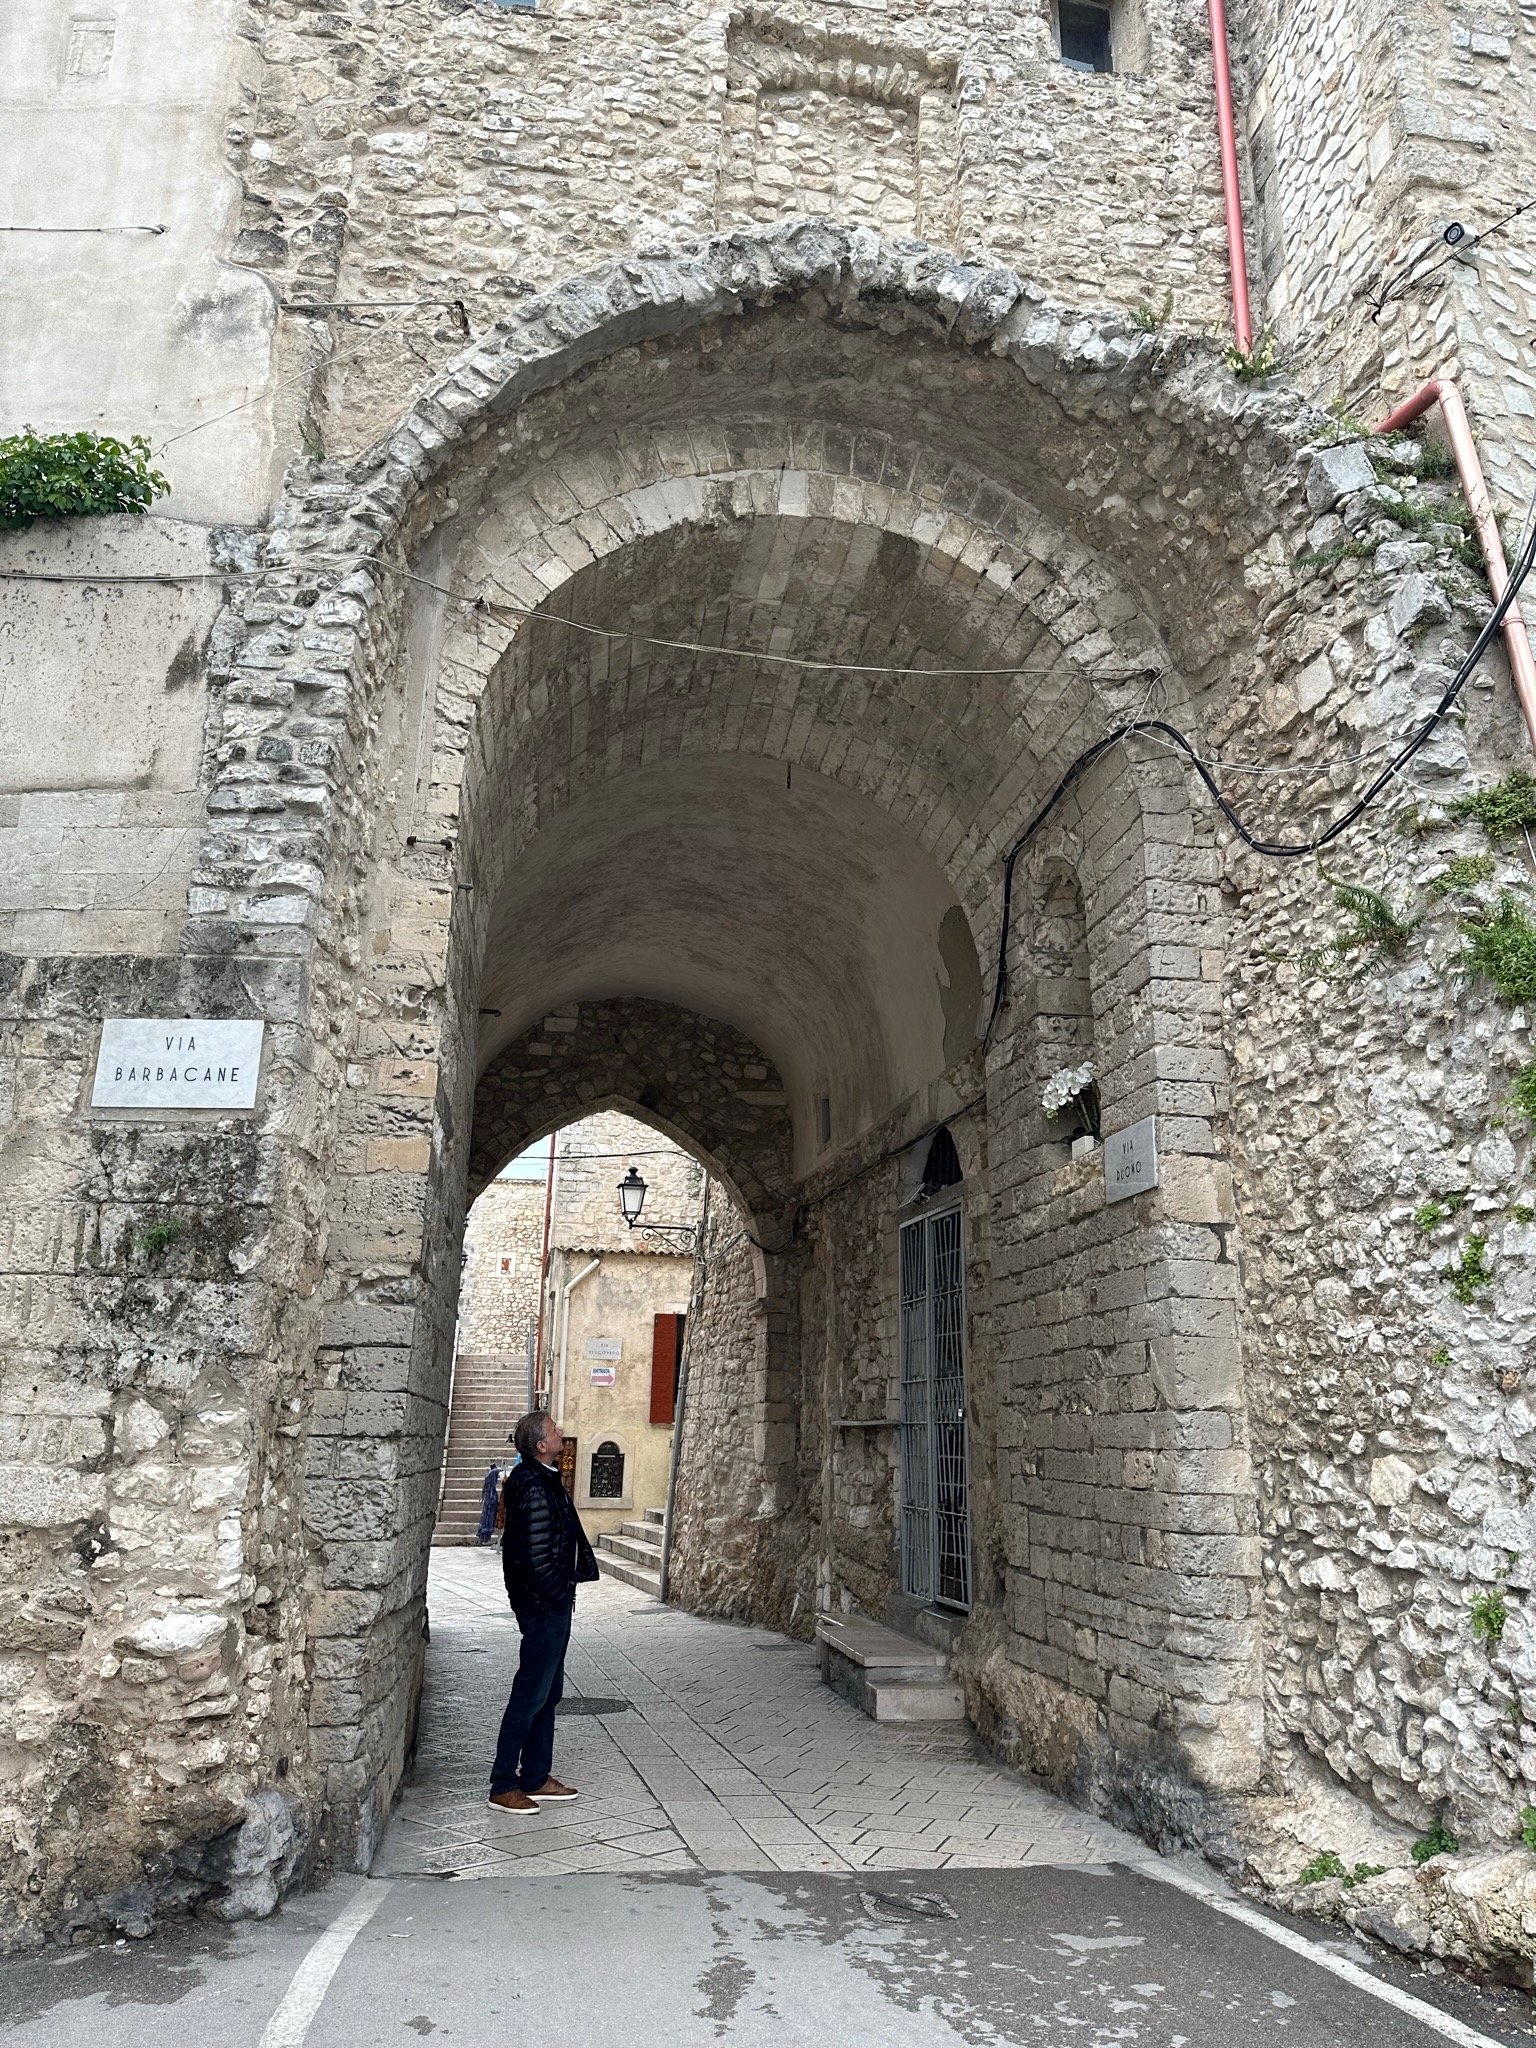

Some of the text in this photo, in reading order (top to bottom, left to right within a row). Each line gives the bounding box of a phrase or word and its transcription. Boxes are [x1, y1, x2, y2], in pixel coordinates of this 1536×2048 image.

[165, 1036, 196, 1051] VIA
[114, 1066, 240, 1082] BARBACANE
[1122, 1139, 1134, 1154] VIA
[1116, 1160, 1142, 1182] DUOMO
